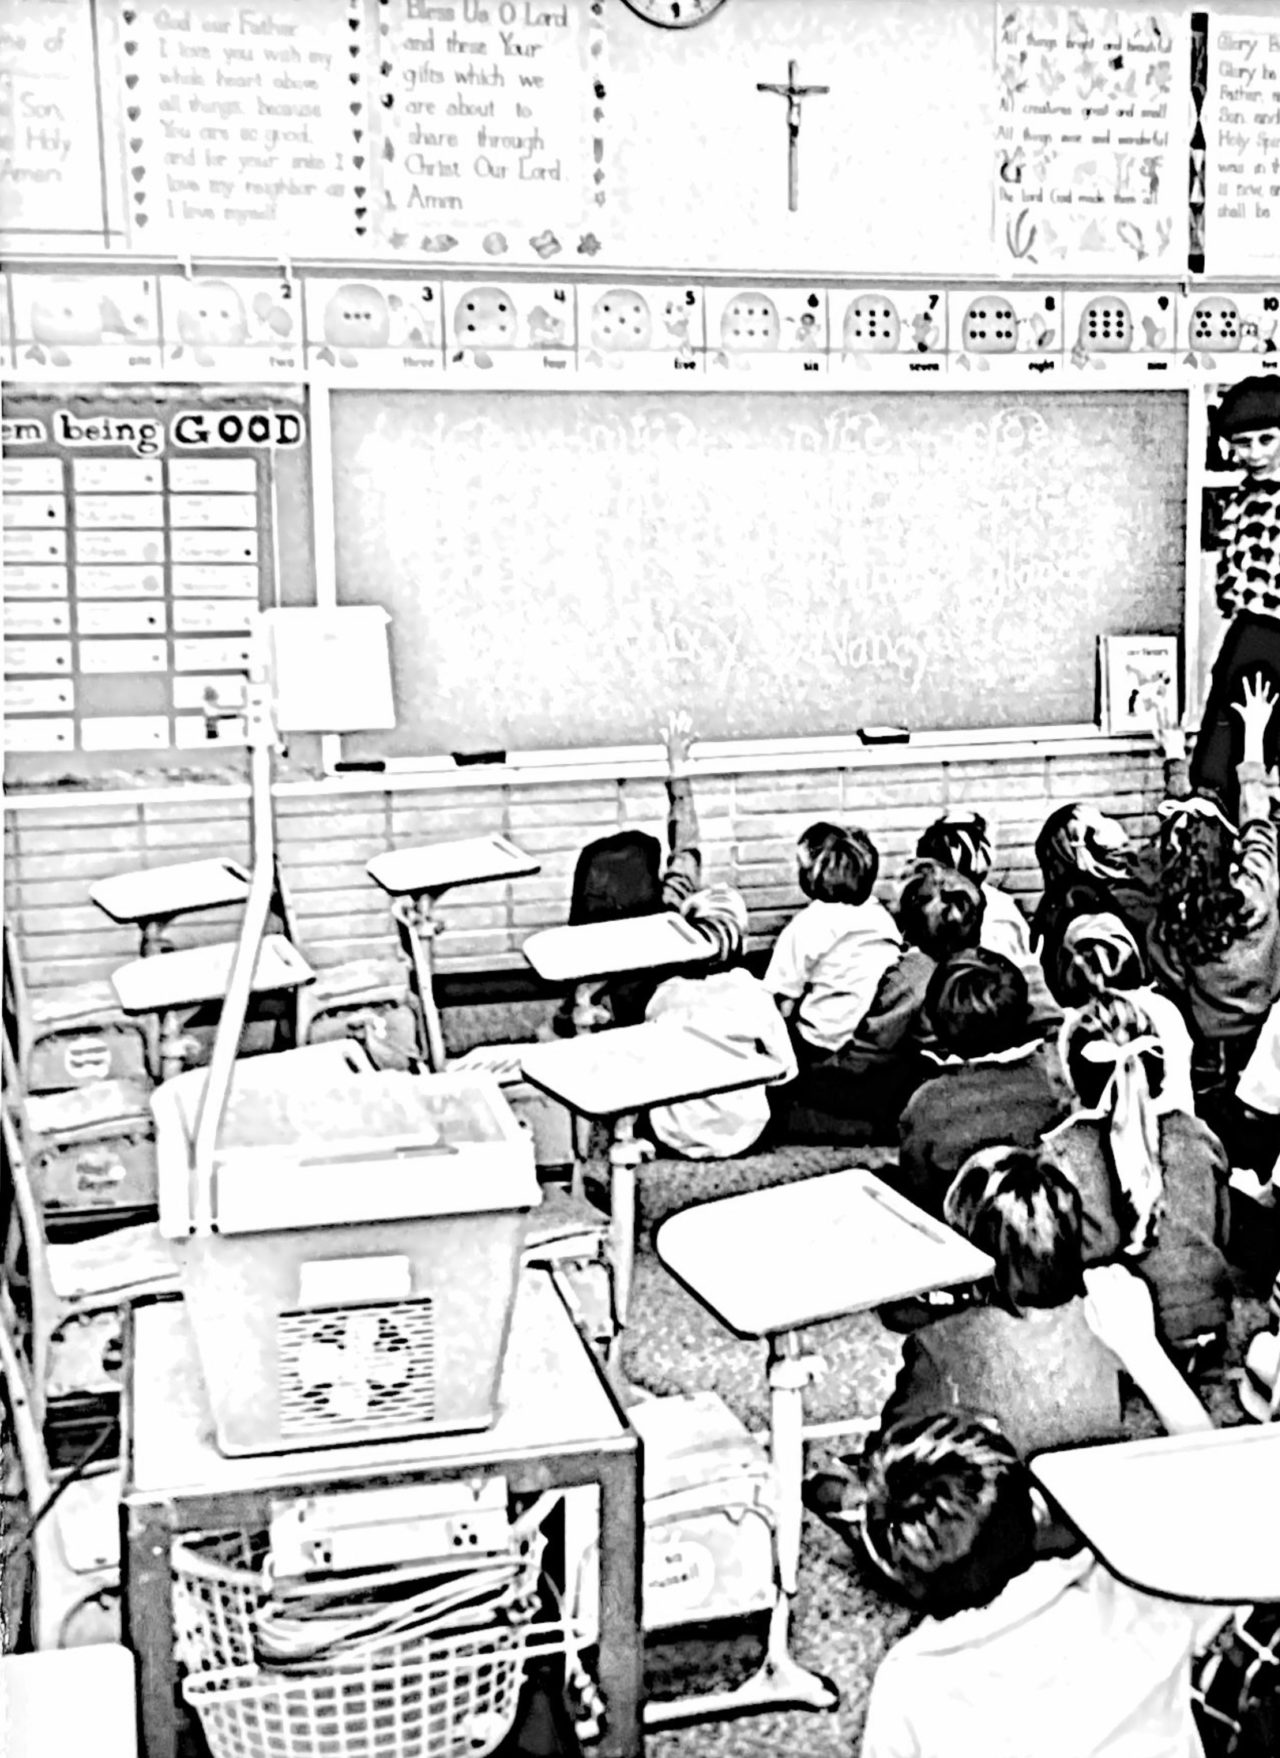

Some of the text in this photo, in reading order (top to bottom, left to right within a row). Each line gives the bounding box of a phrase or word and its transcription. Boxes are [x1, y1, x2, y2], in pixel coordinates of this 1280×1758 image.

[500, 2, 515, 23] O
[526, 2, 567, 26] Lord
[402, 27, 435, 52] and
[498, 30, 544, 58] Your
[454, 62, 505, 87] which
[518, 74, 544, 89] we
[405, 91, 533, 118] are about to
[408, 122, 545, 159] share through
[1218, 129, 1250, 156] Holy
[474, 155, 508, 179] Our
[280, 281, 292, 300] 2
[421, 286, 434, 302] 3
[685, 290, 696, 306] 5
[928, 294, 940, 310] 7
[1263, 296, 1279, 312] 10
[61, 415, 157, 456] being
[176, 415, 299, 444] GOOD
